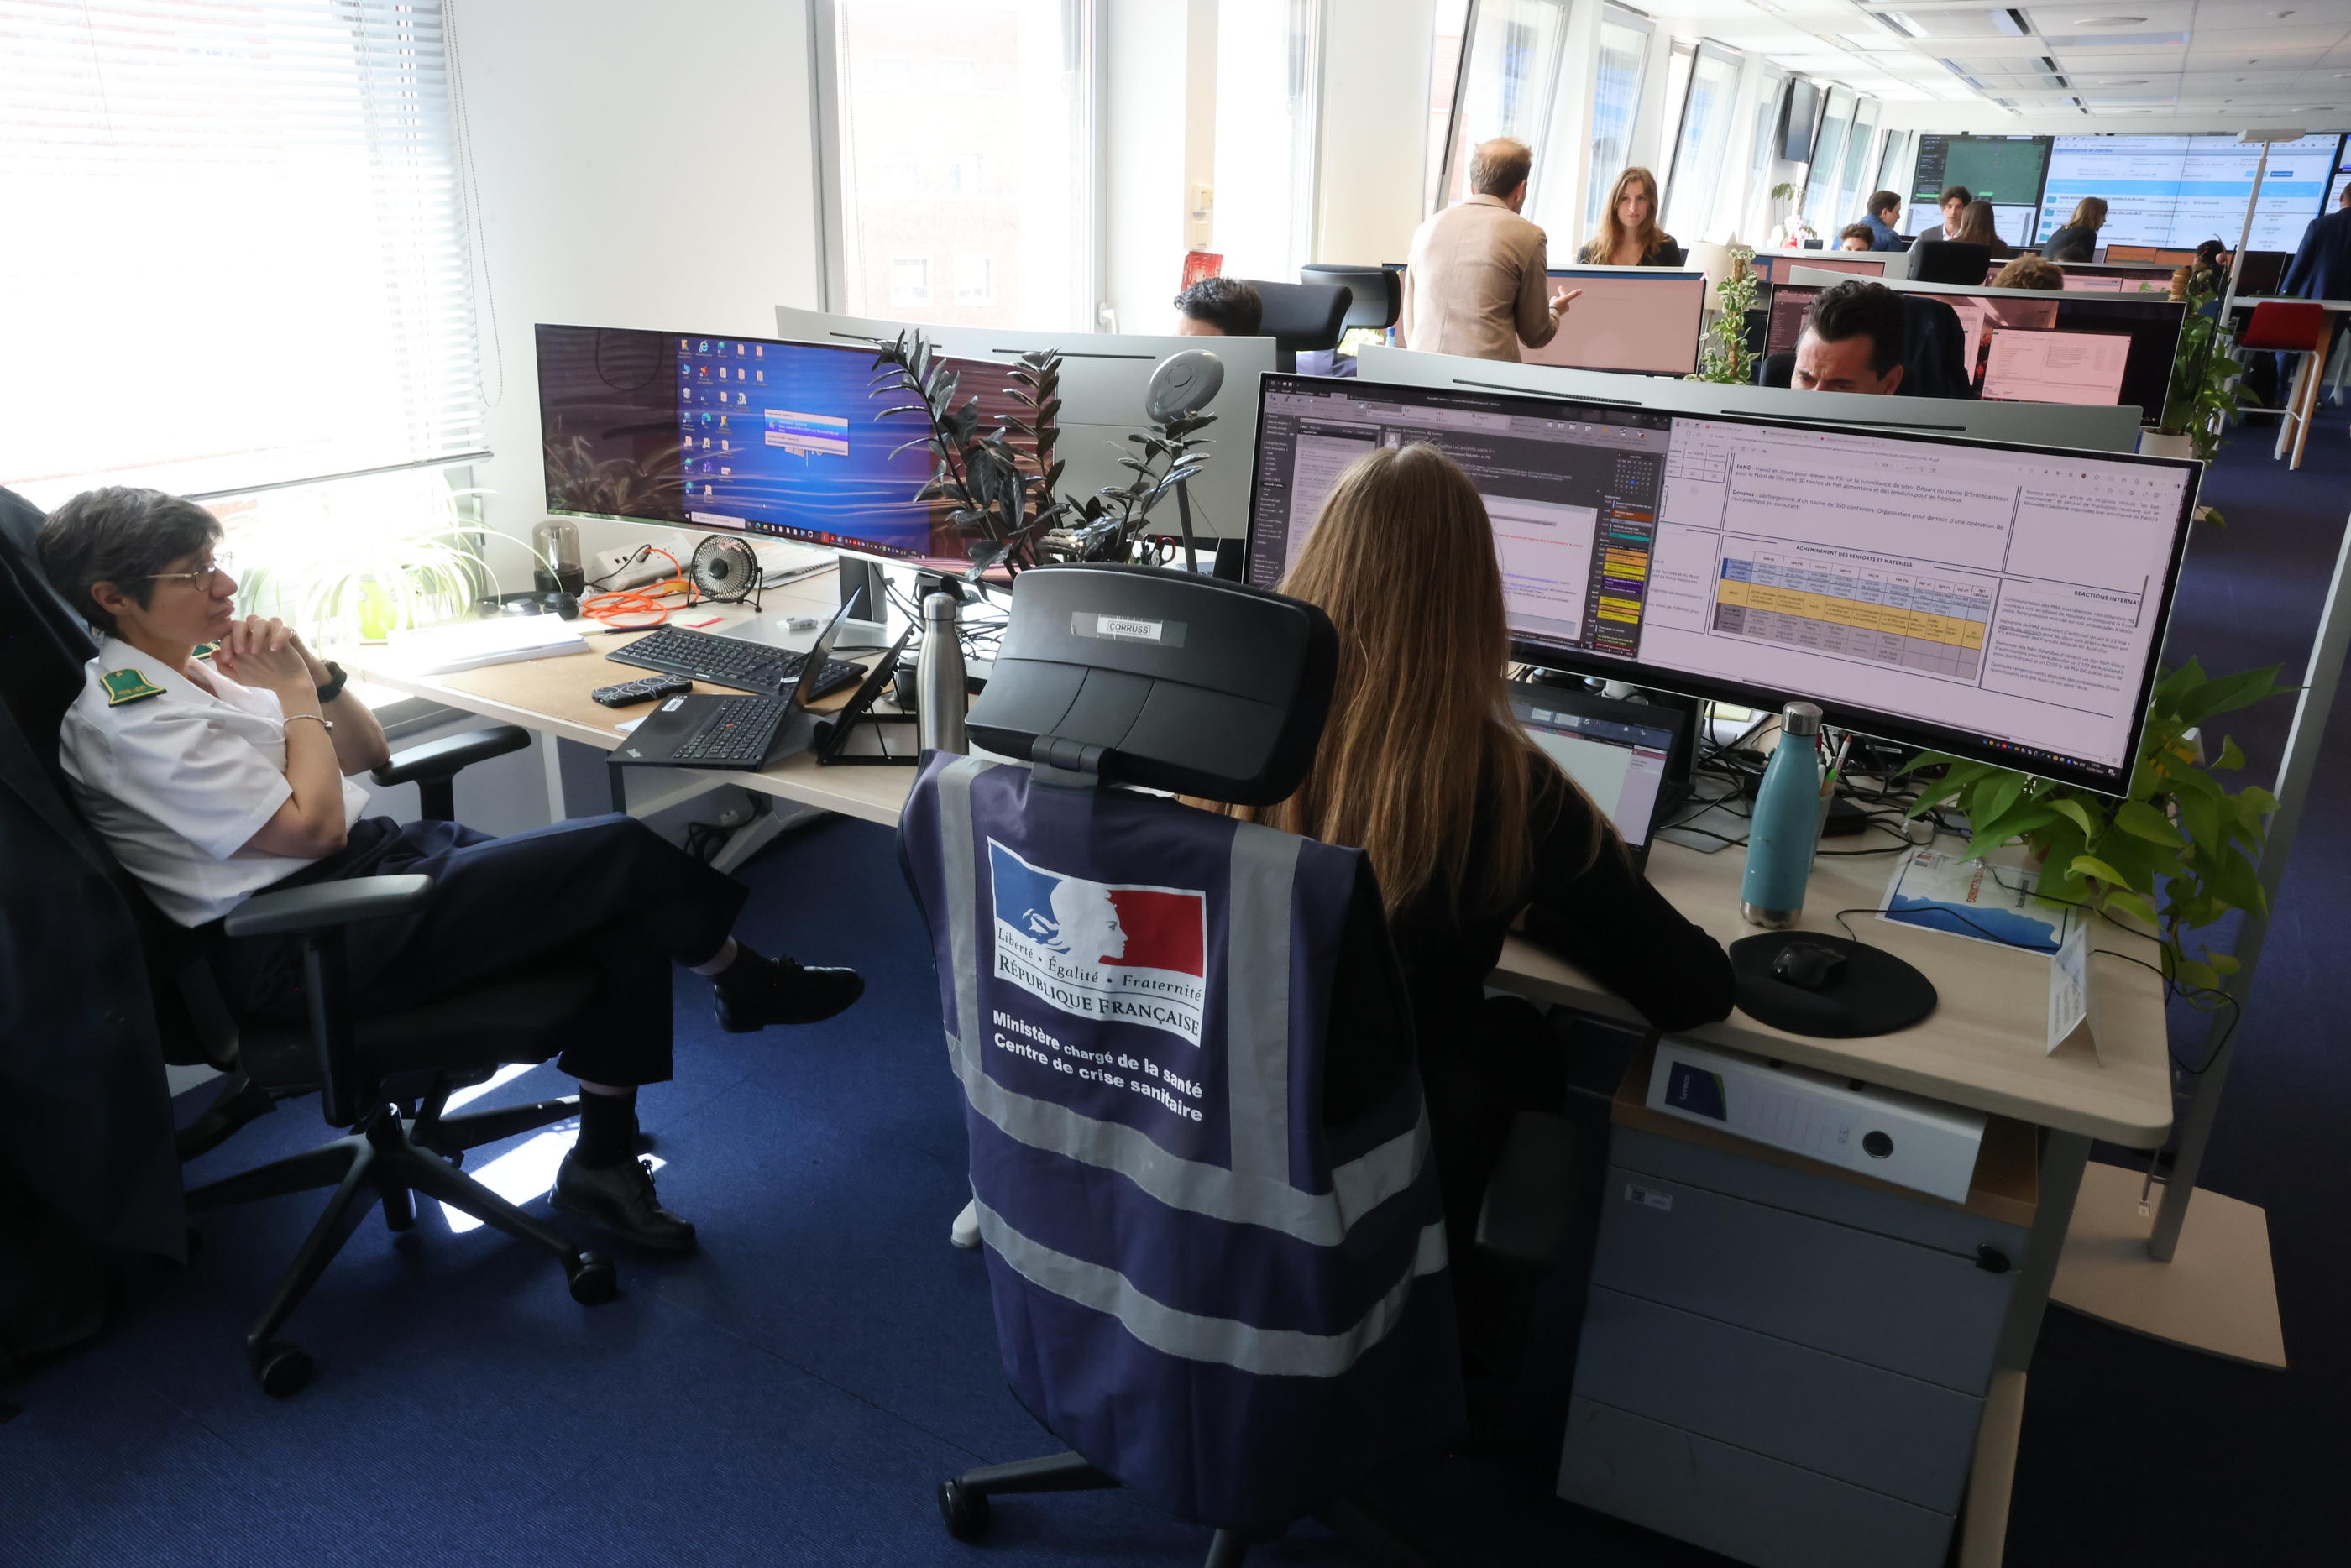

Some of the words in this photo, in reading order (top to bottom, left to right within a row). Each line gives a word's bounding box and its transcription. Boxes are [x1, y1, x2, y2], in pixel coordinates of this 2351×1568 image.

[1796, 546, 1837, 556] ACHEMINEMENT
[1884, 559, 1913, 567] MATERIELS
[1109, 623, 1149, 634] CORRUSS
[2075, 591, 2108, 600] REACTIONS
[998, 927, 1034, 959] Liberté
[1049, 955, 1098, 983] Égalité
[1123, 975, 1202, 1001] Fraternité
[999, 954, 1092, 1011] RÉPUBLIQUE
[1098, 997, 1199, 1037] FRANÇAISE
[993, 1010, 1060, 1050] Ministère
[1063, 1045, 1113, 1065] chargé
[1118, 1054, 1139, 1070] de
[1144, 1058, 1159, 1077] la
[1163, 1069, 1202, 1098] santé
[994, 1032, 1049, 1065] Centre
[1053, 1058, 1074, 1074] de
[1079, 1069, 1124, 1088] crise
[1130, 1079, 1202, 1121] sanitaire
